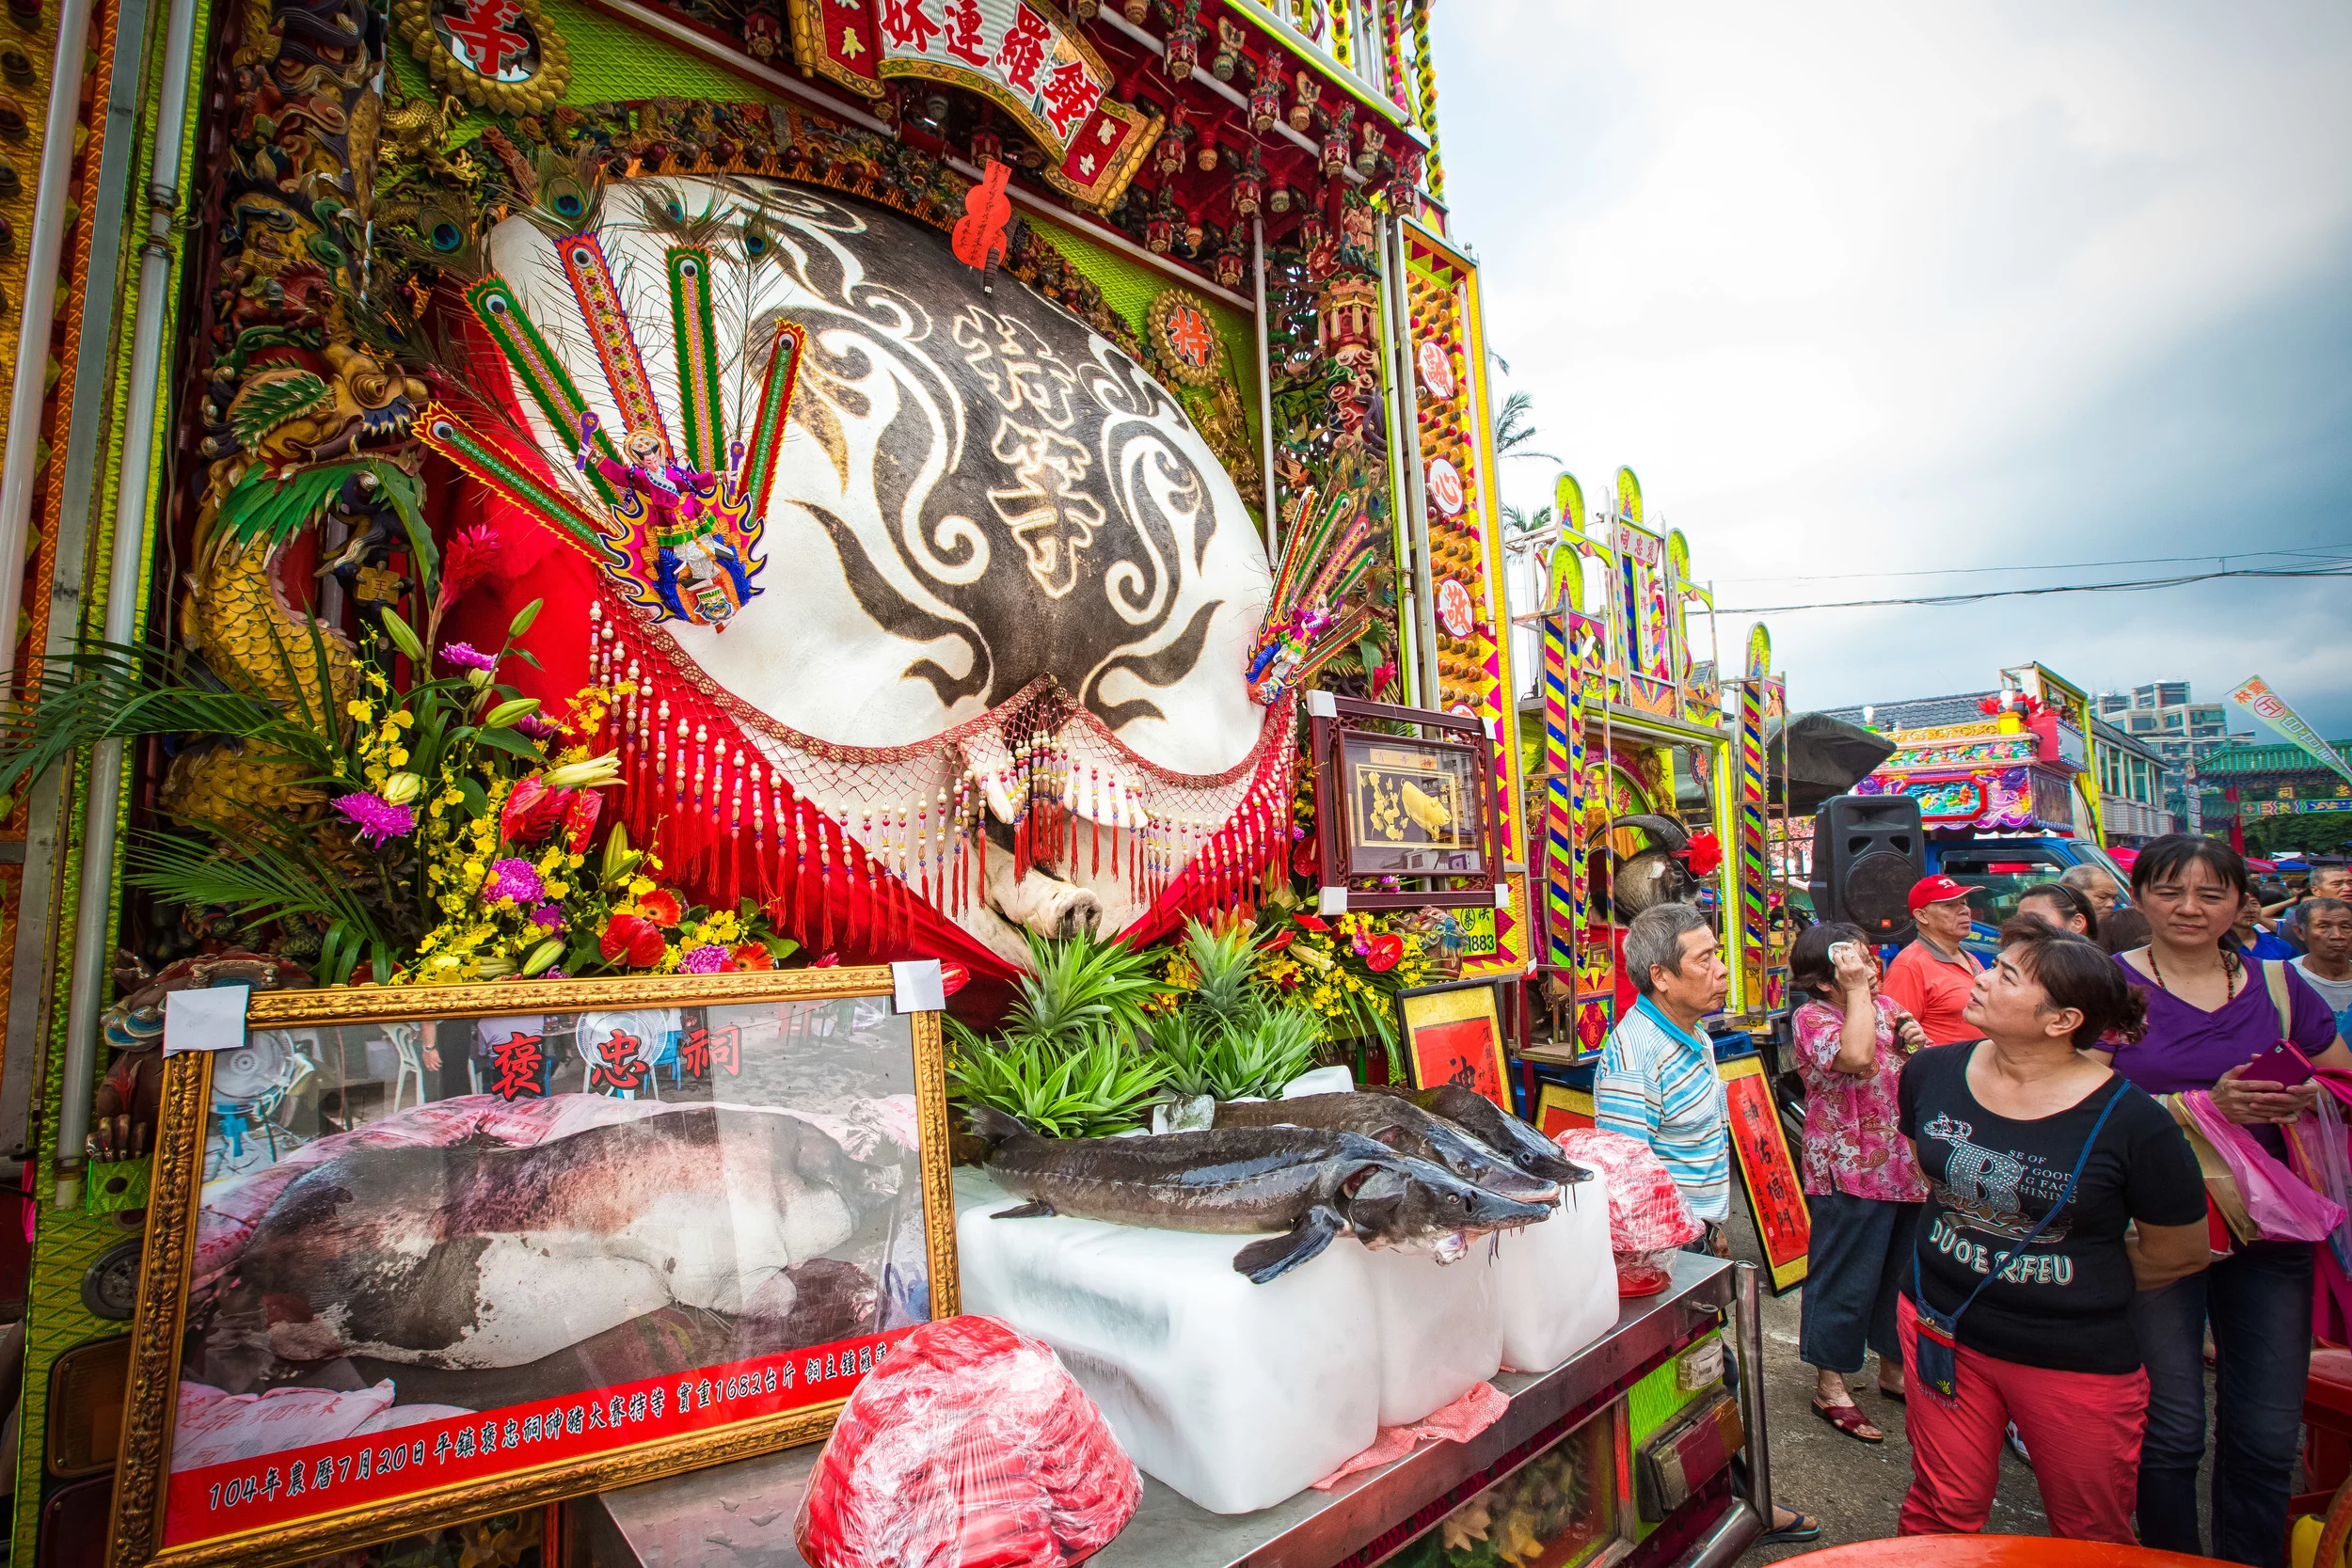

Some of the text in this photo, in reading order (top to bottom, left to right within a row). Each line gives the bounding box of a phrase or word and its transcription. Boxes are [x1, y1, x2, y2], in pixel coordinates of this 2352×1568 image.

[1167, 304, 1213, 367] 特
[1467, 934, 1495, 952] 1883
[491, 1025, 742, 1103] 褒忠祠
[2027, 1154, 2047, 1164] OF
